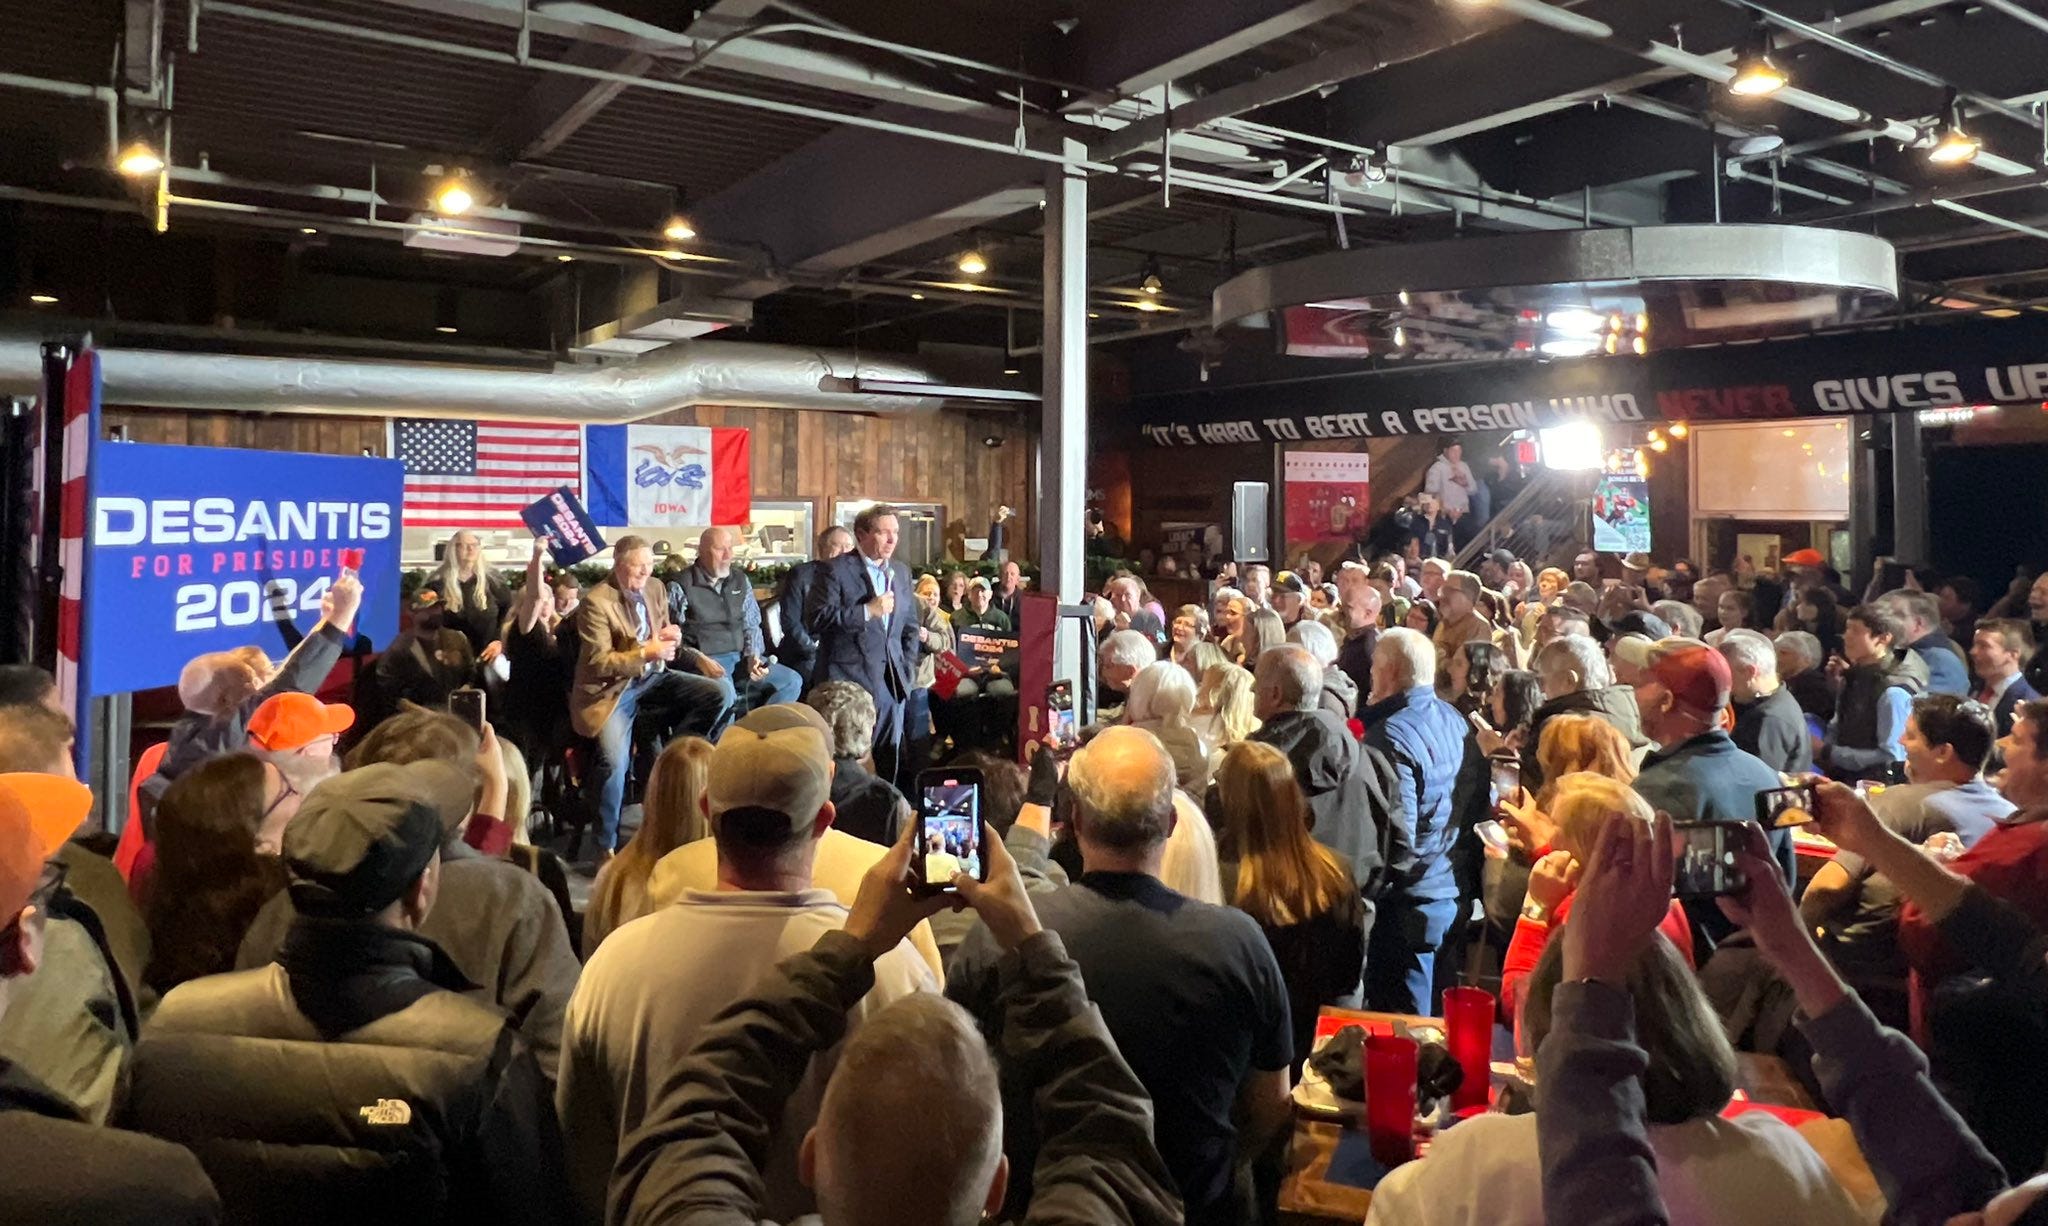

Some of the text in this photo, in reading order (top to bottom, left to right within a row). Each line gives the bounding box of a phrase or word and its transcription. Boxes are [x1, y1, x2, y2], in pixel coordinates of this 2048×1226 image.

[1198, 420, 1261, 444] HARD
[1263, 418, 1300, 440] TO
[1304, 412, 1373, 438] BEAT
[1381, 410, 1408, 434] A
[1412, 401, 1538, 434] PERSON
[1549, 393, 1645, 423] WHO
[1656, 384, 1797, 419] NEVER
[1812, 371, 1965, 412] GIVES
[95, 497, 391, 546] DESANTIS
[654, 503, 687, 514] IOWA
[131, 554, 194, 579] FOR
[175, 576, 332, 632] 2024
